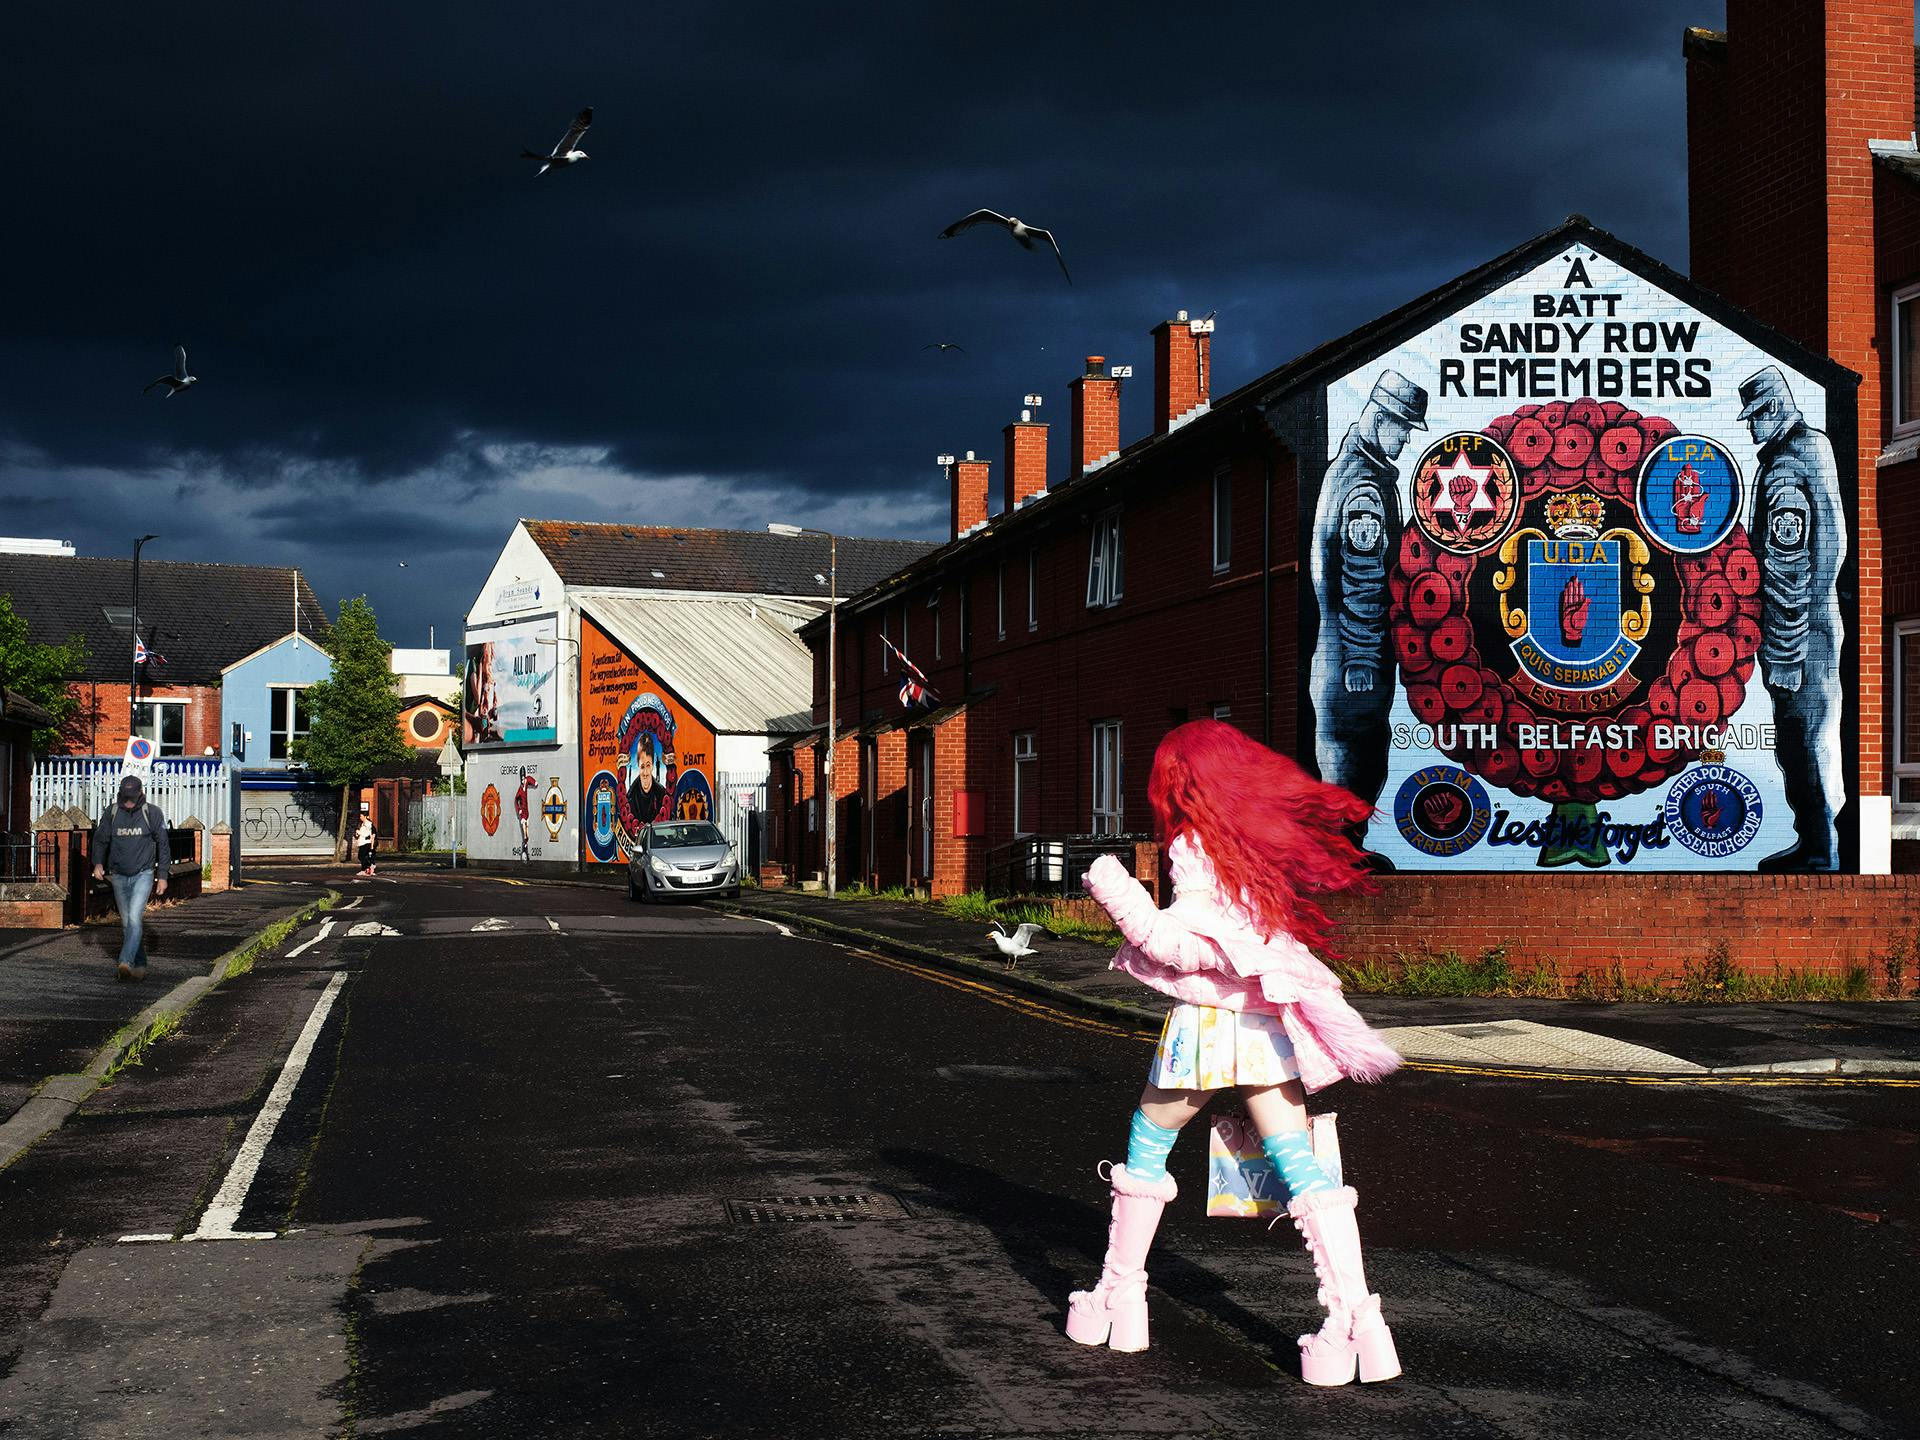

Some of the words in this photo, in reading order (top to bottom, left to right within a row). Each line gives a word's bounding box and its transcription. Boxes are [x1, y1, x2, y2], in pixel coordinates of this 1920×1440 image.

[1533, 293, 1623, 318] BATT
[1459, 321, 1595, 354] SANDY
[1603, 321, 1701, 354] ROW
[1439, 358, 1712, 398] REMEMBERS
[1668, 444, 1716, 462] L.P.A
[1543, 541, 1609, 564] U.D.A
[513, 656, 523, 676] ALL
[525, 653, 537, 675] OUT
[1554, 643, 1628, 684] SEPARABIT
[1528, 683, 1572, 712] EST.
[1578, 687, 1622, 713] 1971
[590, 712, 612, 728] South
[623, 713, 631, 726] IN
[590, 727, 615, 742] Belfast
[1392, 722, 1498, 751] SOUTH
[1518, 722, 1637, 751] BELFAST
[1653, 722, 1777, 751] BRIGADE
[588, 742, 617, 763] Brigade
[501, 765, 518, 775] GEORGE
[527, 764, 538, 774] BEST
[1666, 771, 1702, 817] ULSTER
[1700, 767, 1761, 811] POLITICAL
[1694, 783, 1730, 796] SOUTH
[1668, 816, 1737, 857] RESEARCH
[1733, 810, 1761, 847] GROUP
[1694, 826, 1732, 840] BELFAST
